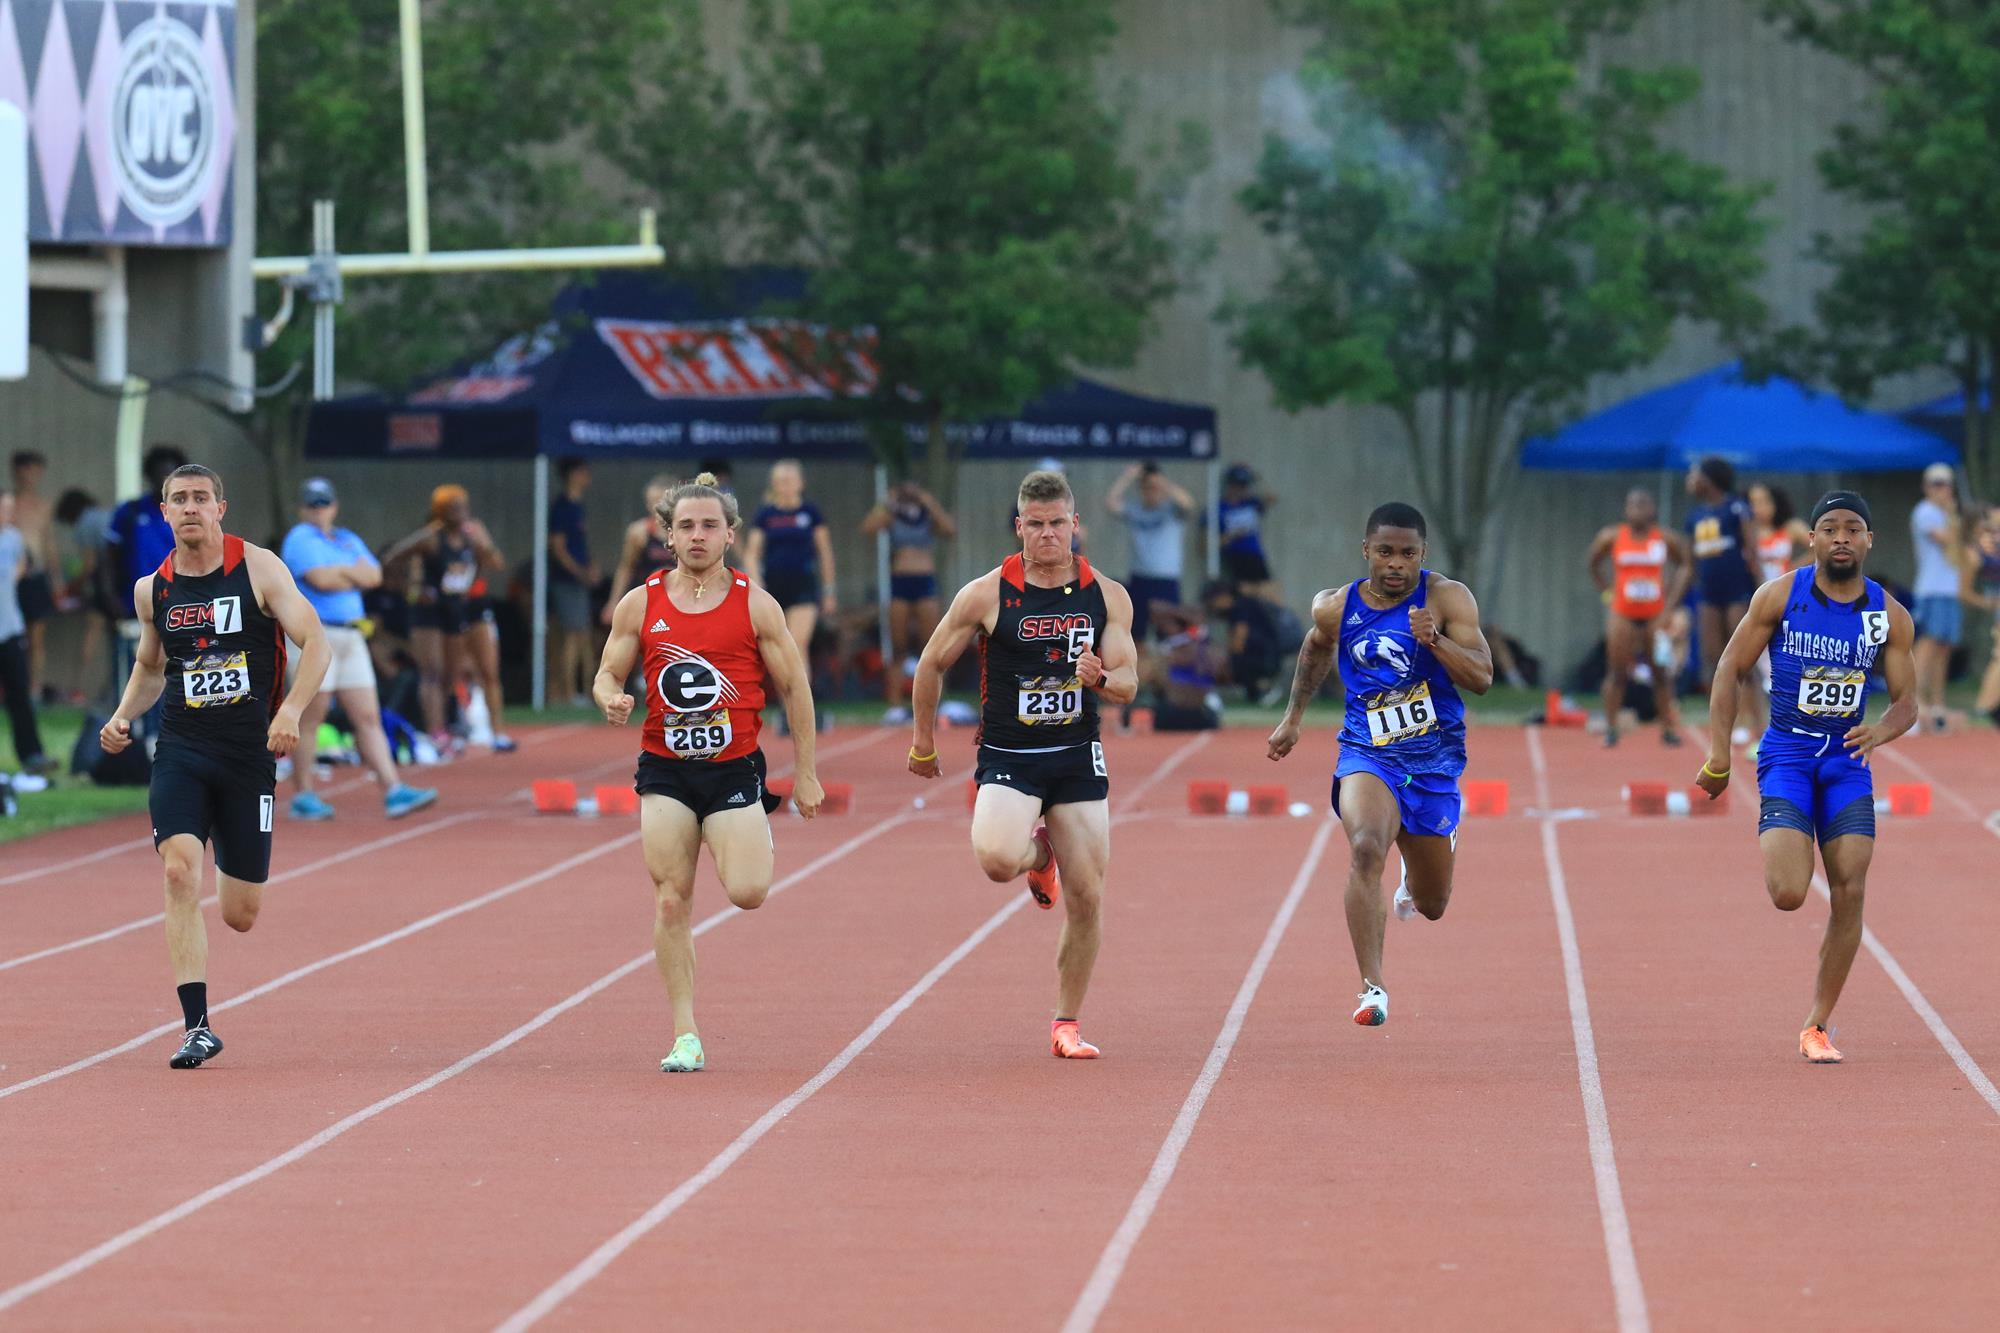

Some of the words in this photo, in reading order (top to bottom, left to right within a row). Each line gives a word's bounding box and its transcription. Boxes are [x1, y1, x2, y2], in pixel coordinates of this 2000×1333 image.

[129, 83, 197, 163] OVC
[570, 420, 682, 445] BELMONT
[690, 420, 778, 445] BRUINS
[1011, 421, 1081, 446] TRACK
[1091, 422, 1110, 446] &
[1117, 422, 1186, 446] FIELD
[168, 604, 215, 629] SEM
[218, 599, 235, 632] 7
[1069, 630, 1090, 660] 5
[1782, 620, 1850, 665] Tennessee
[190, 668, 242, 697] 223
[660, 660, 719, 711] e
[1806, 682, 1857, 707] 299
[1026, 690, 1076, 715] 230
[1377, 699, 1428, 734] 116
[672, 725, 726, 751] 269
[263, 797, 271, 830] 7
